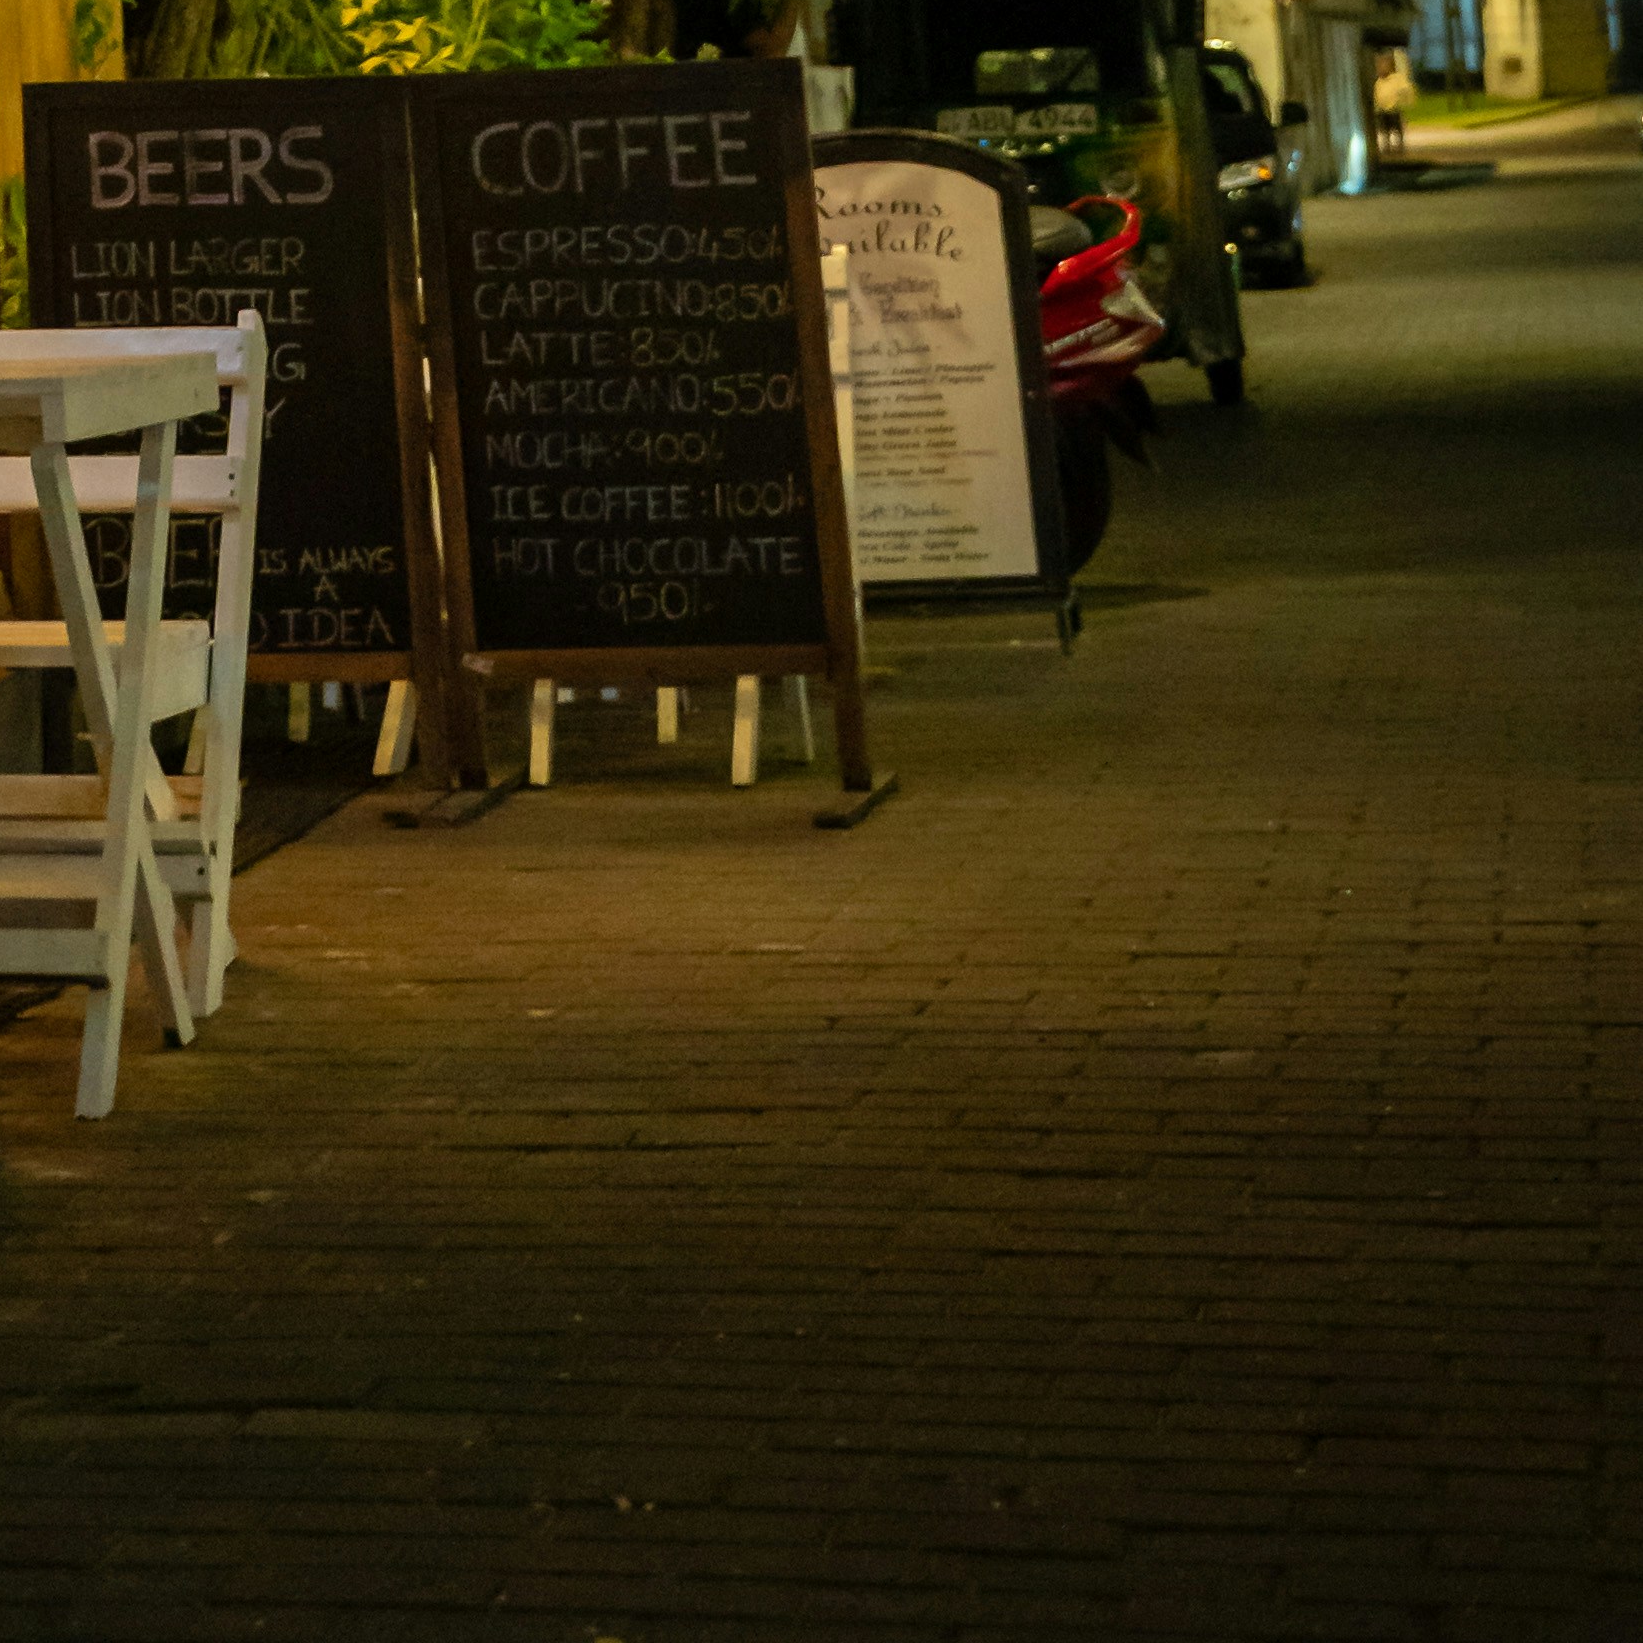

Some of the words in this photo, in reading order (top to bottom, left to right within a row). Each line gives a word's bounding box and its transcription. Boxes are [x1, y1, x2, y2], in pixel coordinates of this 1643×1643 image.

[87, 124, 336, 210] BEERS
[469, 110, 759, 198] COFFEE
[70, 239, 156, 280] LION
[73, 289, 158, 327] LION
[169, 287, 315, 326] BOTTLE
[490, 483, 552, 522] ICE
[559, 482, 692, 523] COFFEE
[259, 545, 289, 576] IS
[492, 535, 560, 579] HOT
[572, 533, 805, 577] CHOCOLATE
[313, 573, 341, 604] A
[278, 608, 395, 649] IDEA
